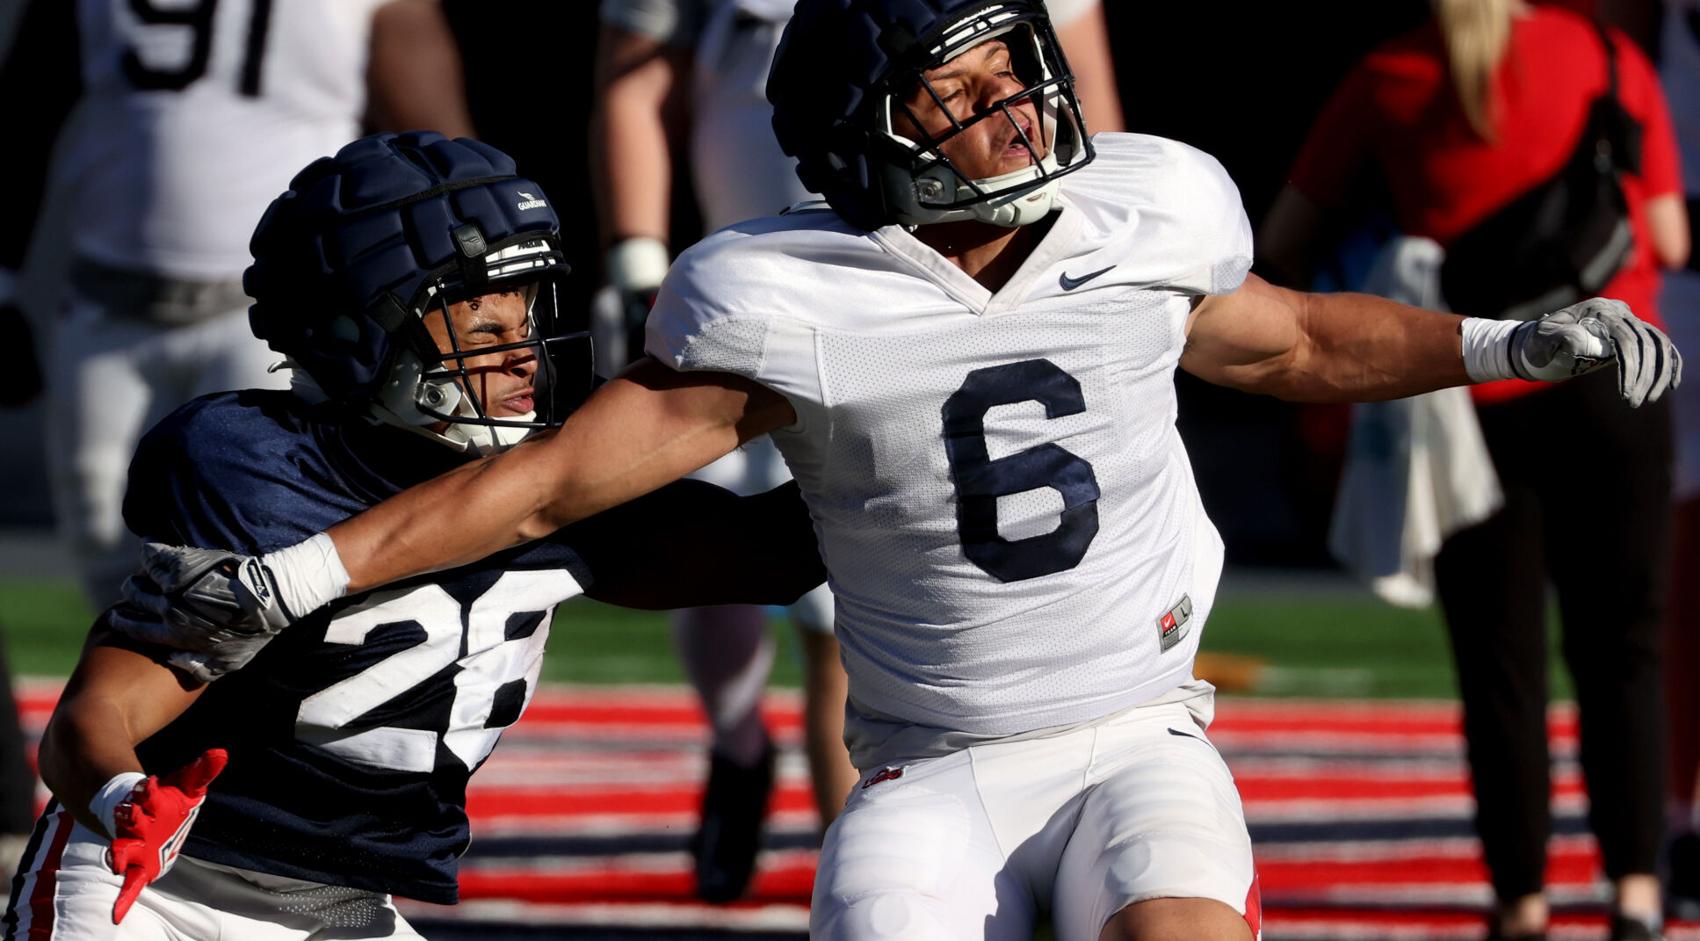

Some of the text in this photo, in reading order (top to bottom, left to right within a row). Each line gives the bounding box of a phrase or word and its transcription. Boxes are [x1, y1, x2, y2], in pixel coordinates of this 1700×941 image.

[122, 0, 272, 96] 91
[941, 358, 1100, 584] 6
[295, 568, 585, 773] 28
